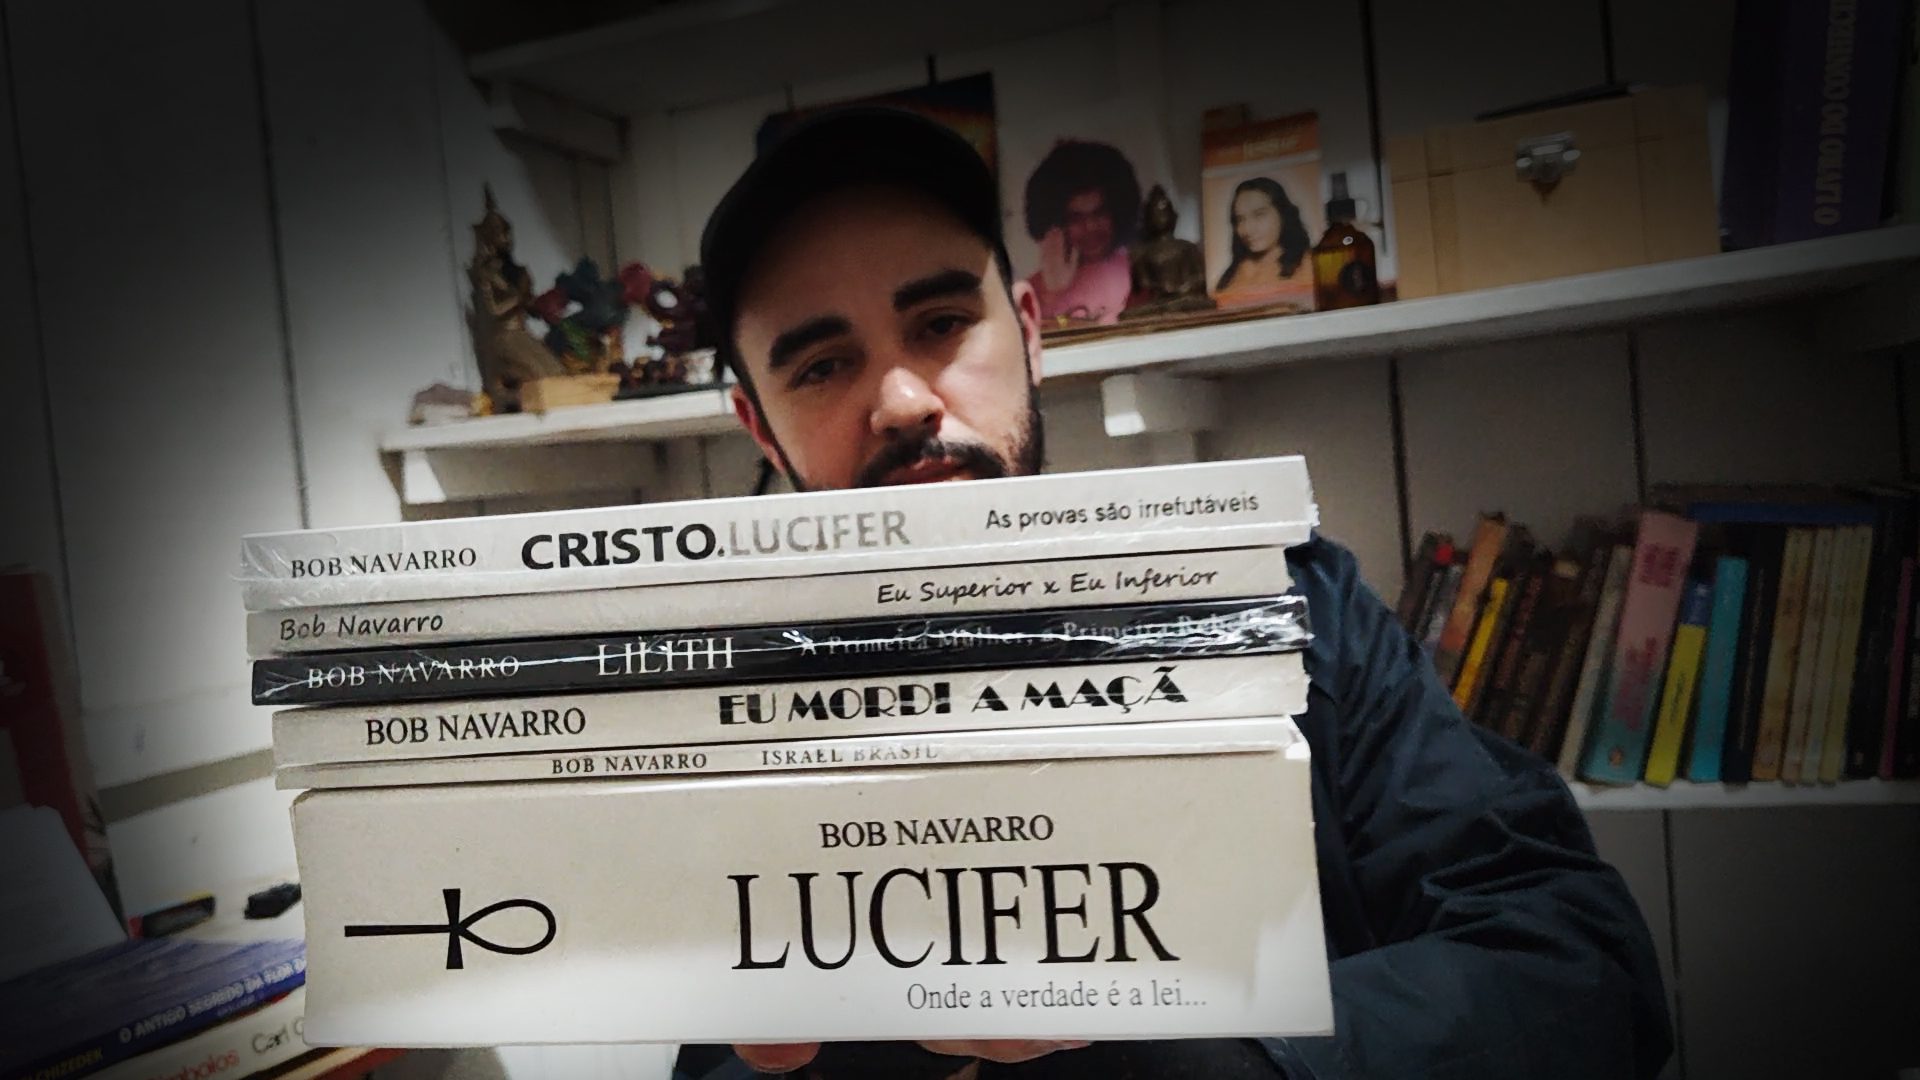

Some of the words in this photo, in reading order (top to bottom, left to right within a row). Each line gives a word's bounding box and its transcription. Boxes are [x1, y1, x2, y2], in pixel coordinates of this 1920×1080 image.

[1813, 204, 1841, 225] O
[290, 556, 343, 579] BOB
[350, 547, 478, 576] NAVARRO
[985, 509, 1013, 531] As
[1018, 507, 1089, 532] provas
[1094, 500, 1132, 522] são
[1138, 491, 1260, 519] irrefutáveis
[280, 615, 326, 641] Bob
[337, 612, 444, 637] Navarro
[877, 583, 912, 605] Eu
[919, 577, 1034, 606] Superior
[1042, 579, 1061, 595] x
[1069, 571, 1104, 594] Eu
[1115, 566, 1219, 593] Inferior
[306, 665, 366, 690] BOB
[377, 655, 521, 686] NAVARRO
[596, 636, 736, 677] LILITH
[365, 717, 430, 746] BOB
[438, 706, 587, 743] NAVARRO
[718, 692, 777, 726] EU
[970, 685, 1010, 714] A
[1019, 665, 1190, 714] MAÇÃ
[550, 757, 596, 776] BOB
[604, 752, 709, 774] NAVARRO
[761, 745, 845, 767] ISRAEL
[852, 742, 940, 764] BRASIL
[819, 820, 886, 850] BOB
[893, 812, 1055, 845] NAVARRO
[726, 860, 1181, 971] LUCIFER
[906, 981, 972, 1010] Onde
[979, 991, 993, 1008] a
[1001, 979, 1099, 1009] verdade
[1107, 980, 1121, 1007] é
[1129, 987, 1144, 1007] a
[1151, 977, 1208, 1008] lei...
[252, 1025, 290, 1053] Carl
